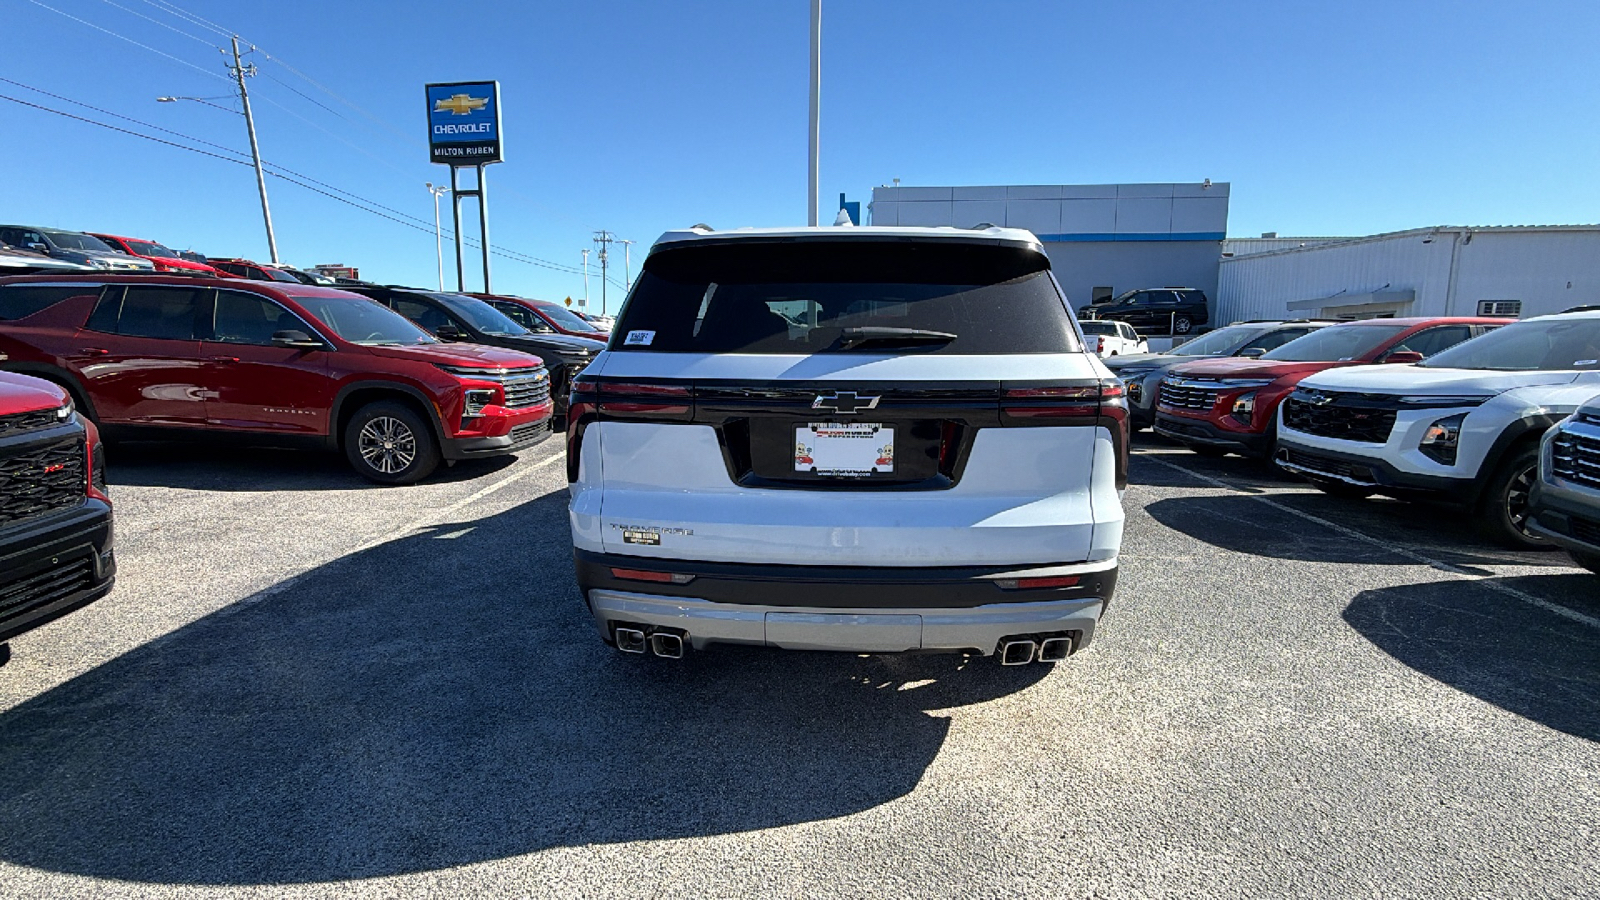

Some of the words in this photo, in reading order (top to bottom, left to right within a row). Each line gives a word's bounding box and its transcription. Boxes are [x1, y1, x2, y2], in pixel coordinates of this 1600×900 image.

[434, 123, 491, 134] CHEVROLET
[434, 147, 464, 156] MILTON
[466, 146, 494, 154] RUBEN
